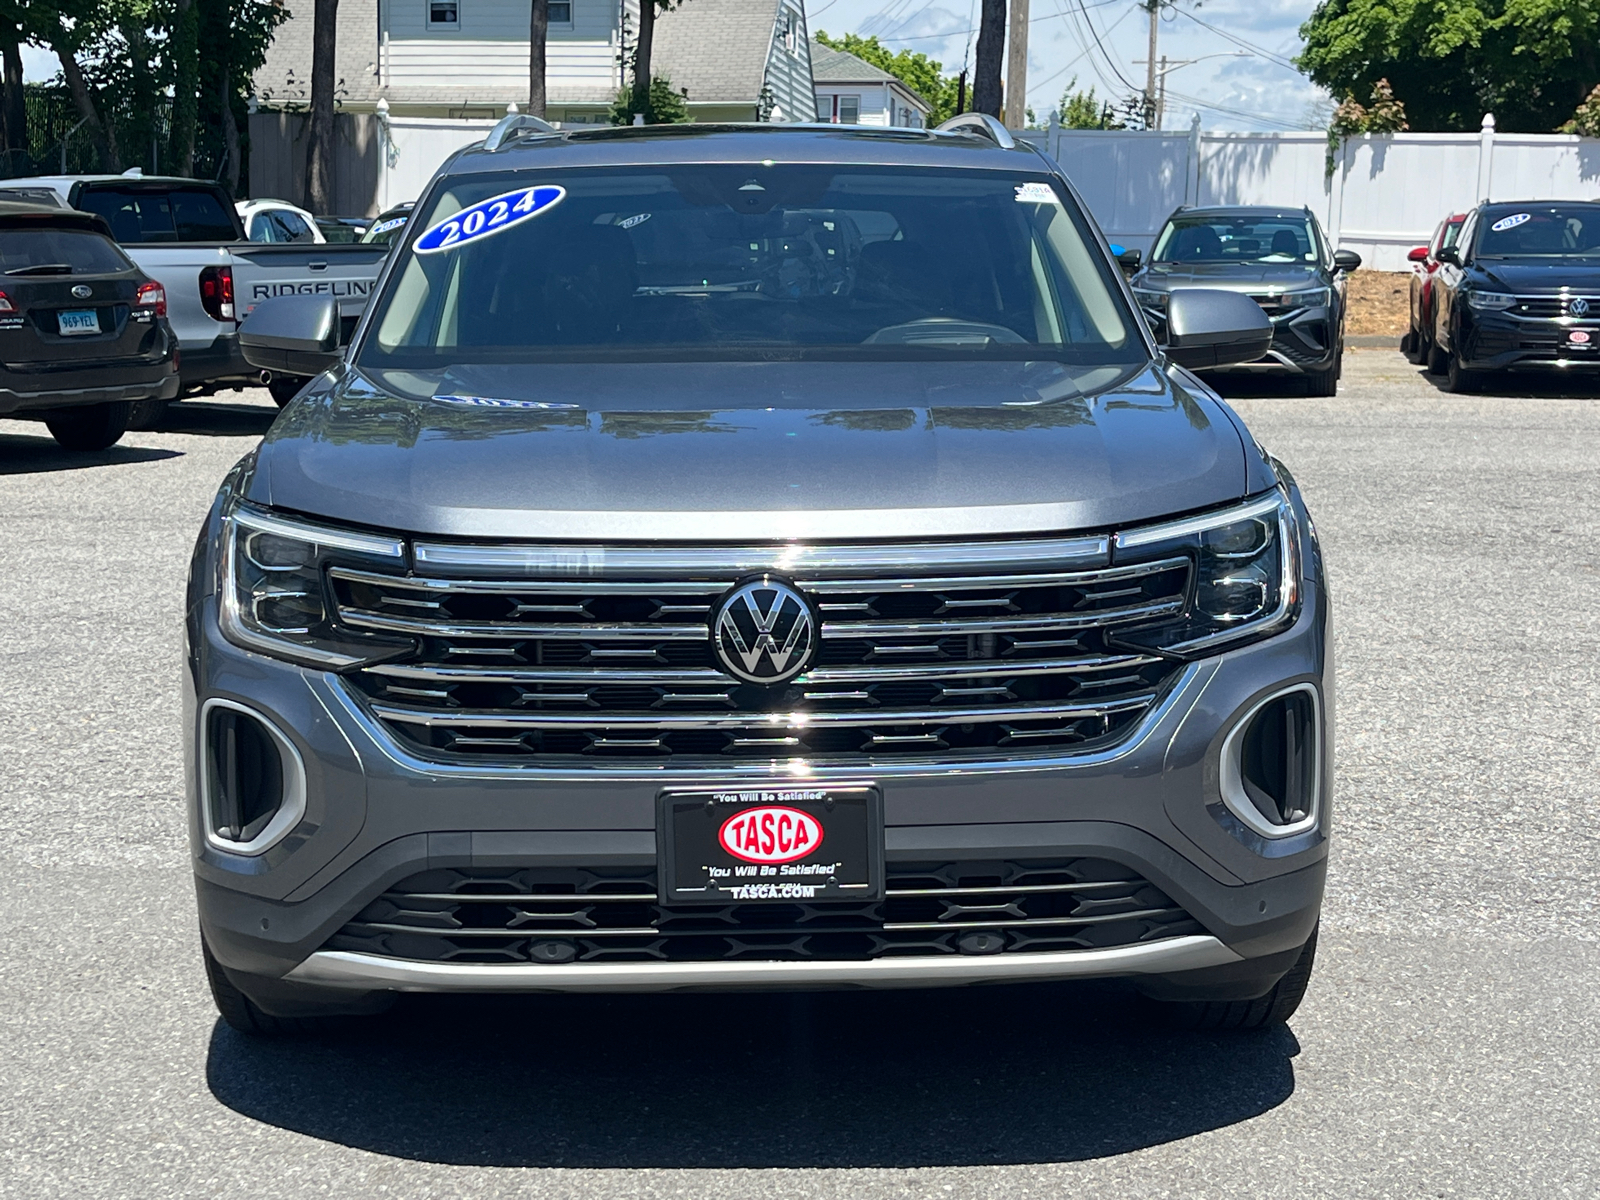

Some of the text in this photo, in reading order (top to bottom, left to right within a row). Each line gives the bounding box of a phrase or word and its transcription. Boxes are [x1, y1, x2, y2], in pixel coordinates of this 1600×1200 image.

[439, 190, 536, 247] 2024
[739, 793, 758, 802] Will
[761, 792, 775, 801] Be
[731, 813, 809, 856] TASCA
[734, 865, 757, 876] Will
[760, 865, 777, 876] Be
[731, 886, 815, 899] TASCA.COM
